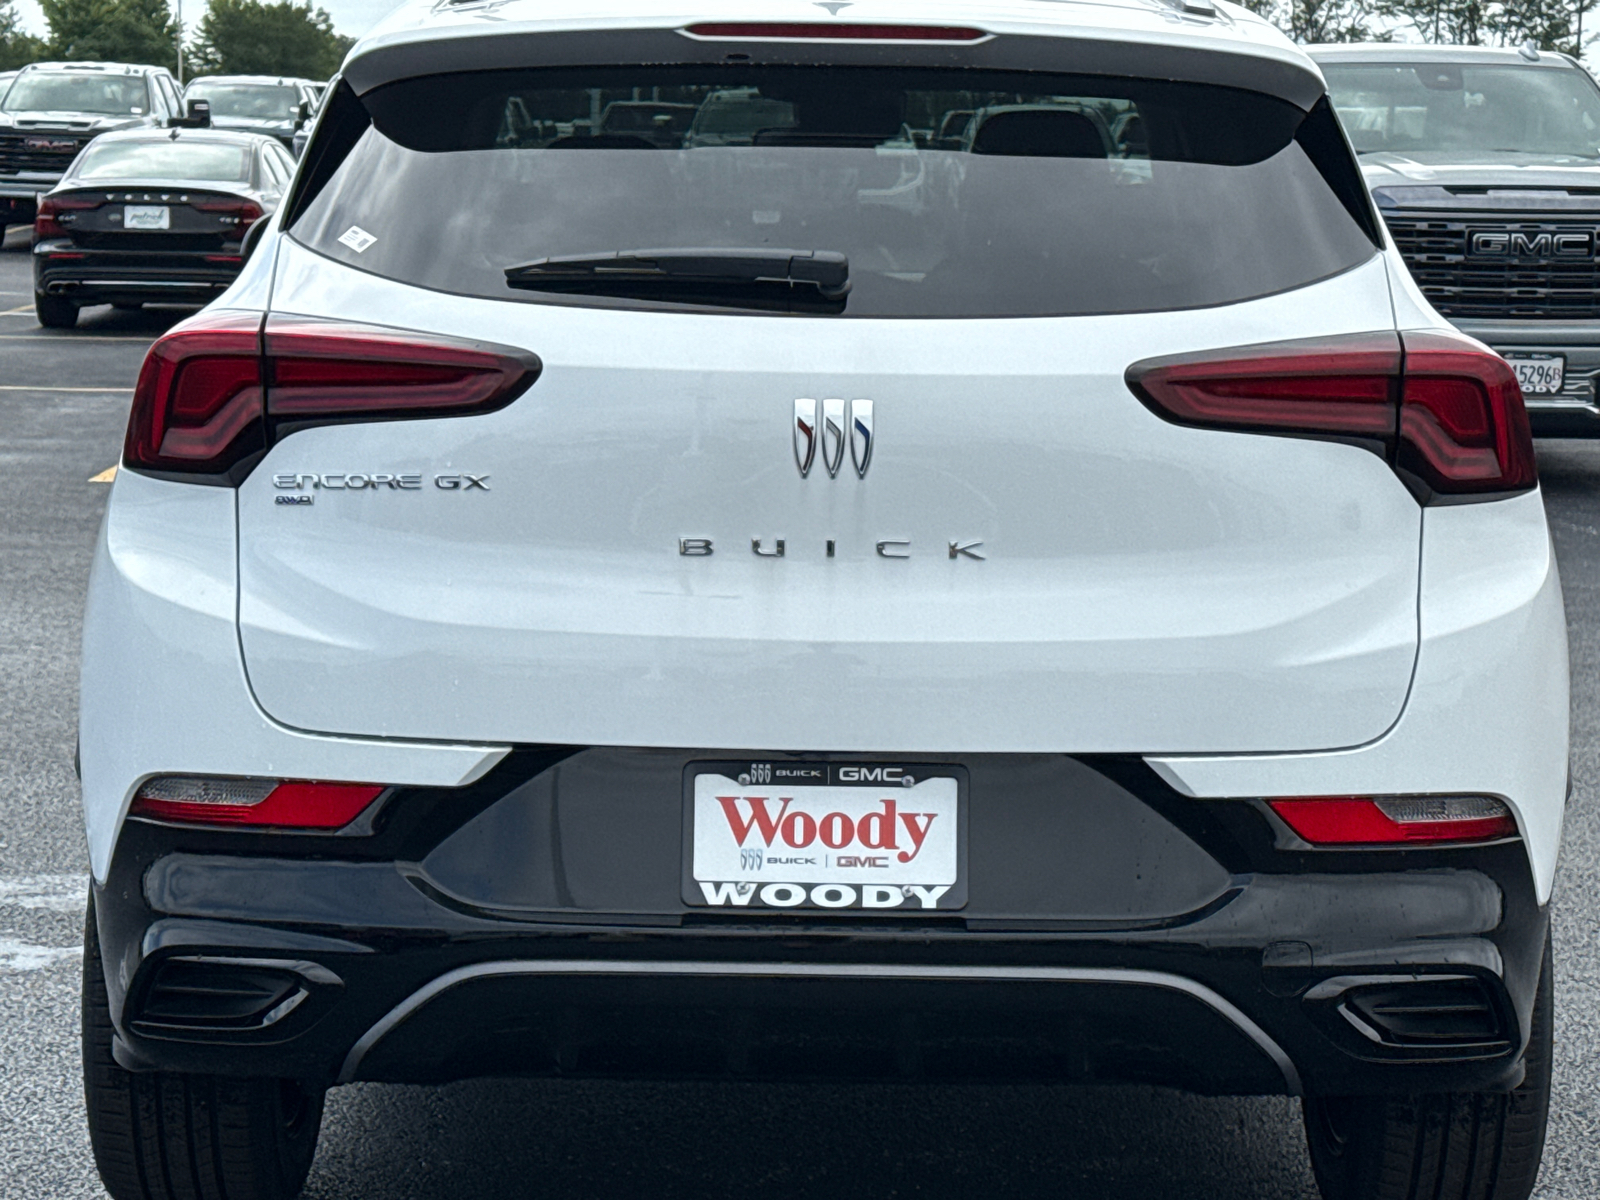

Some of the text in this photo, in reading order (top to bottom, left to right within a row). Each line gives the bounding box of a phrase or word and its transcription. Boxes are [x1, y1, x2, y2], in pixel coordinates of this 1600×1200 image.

[1472, 233, 1590, 256] GMC
[272, 473, 491, 491] ENCORE GX
[679, 537, 986, 560] BUICK
[776, 767, 904, 782] BUICK GMC
[715, 796, 939, 864] Woody
[767, 856, 890, 869] BUICK GMC
[699, 882, 952, 909] WOODY
